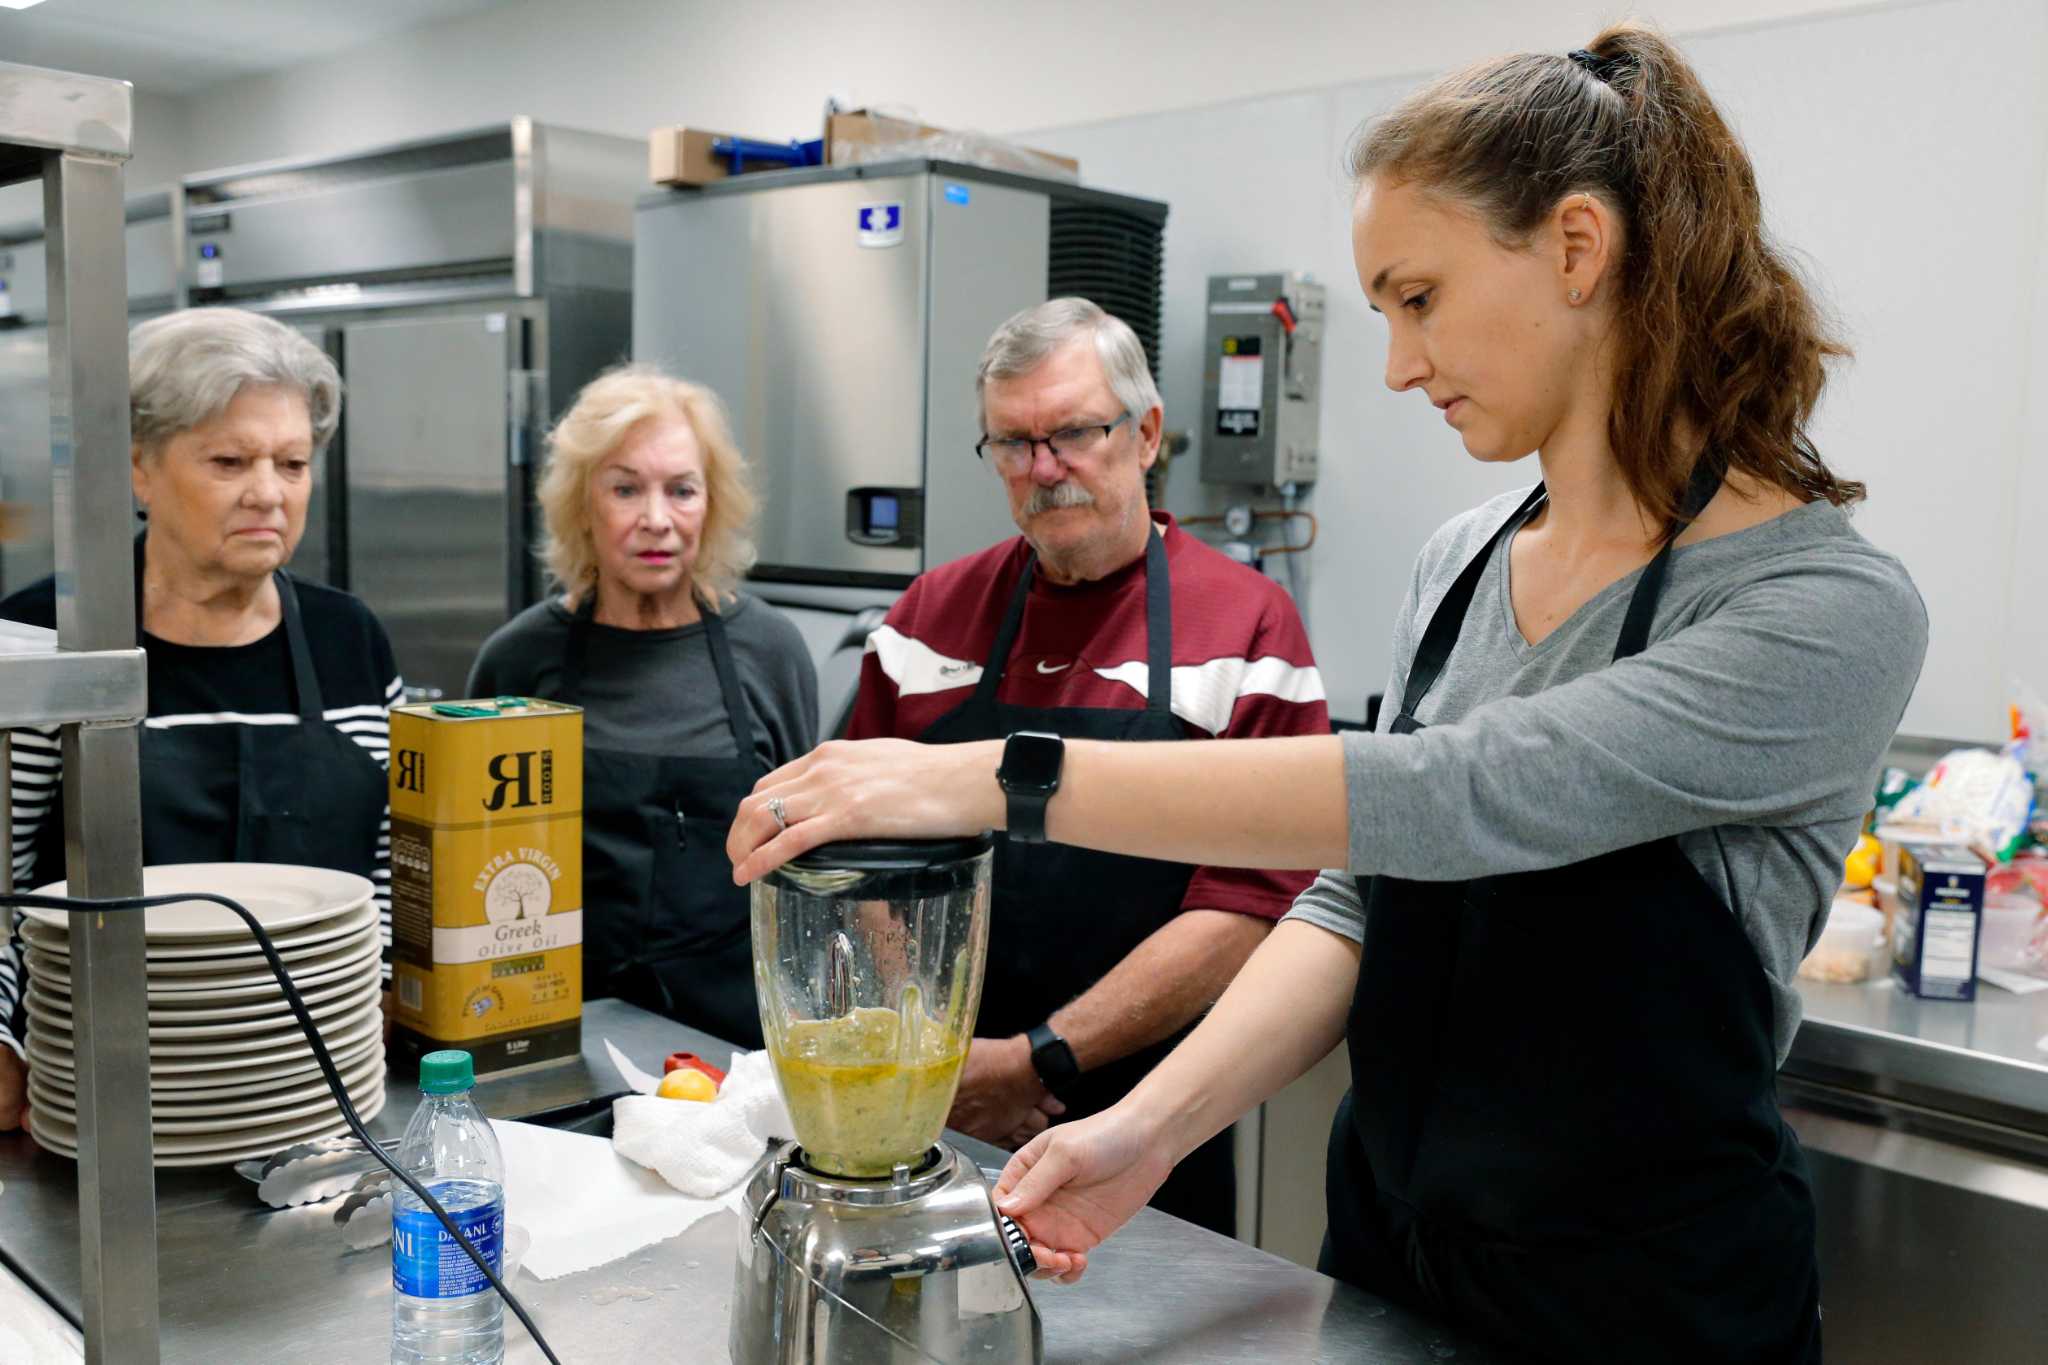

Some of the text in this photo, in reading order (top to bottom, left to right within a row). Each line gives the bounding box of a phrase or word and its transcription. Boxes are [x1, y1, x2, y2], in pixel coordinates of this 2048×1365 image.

[473, 850, 514, 892] EXTRA
[518, 847, 562, 881] VIRGIN
[495, 919, 542, 942] Greek
[478, 933, 558, 958] Olive Oil
[392, 1222, 415, 1257] NI
[438, 1223, 486, 1242] DAANI
